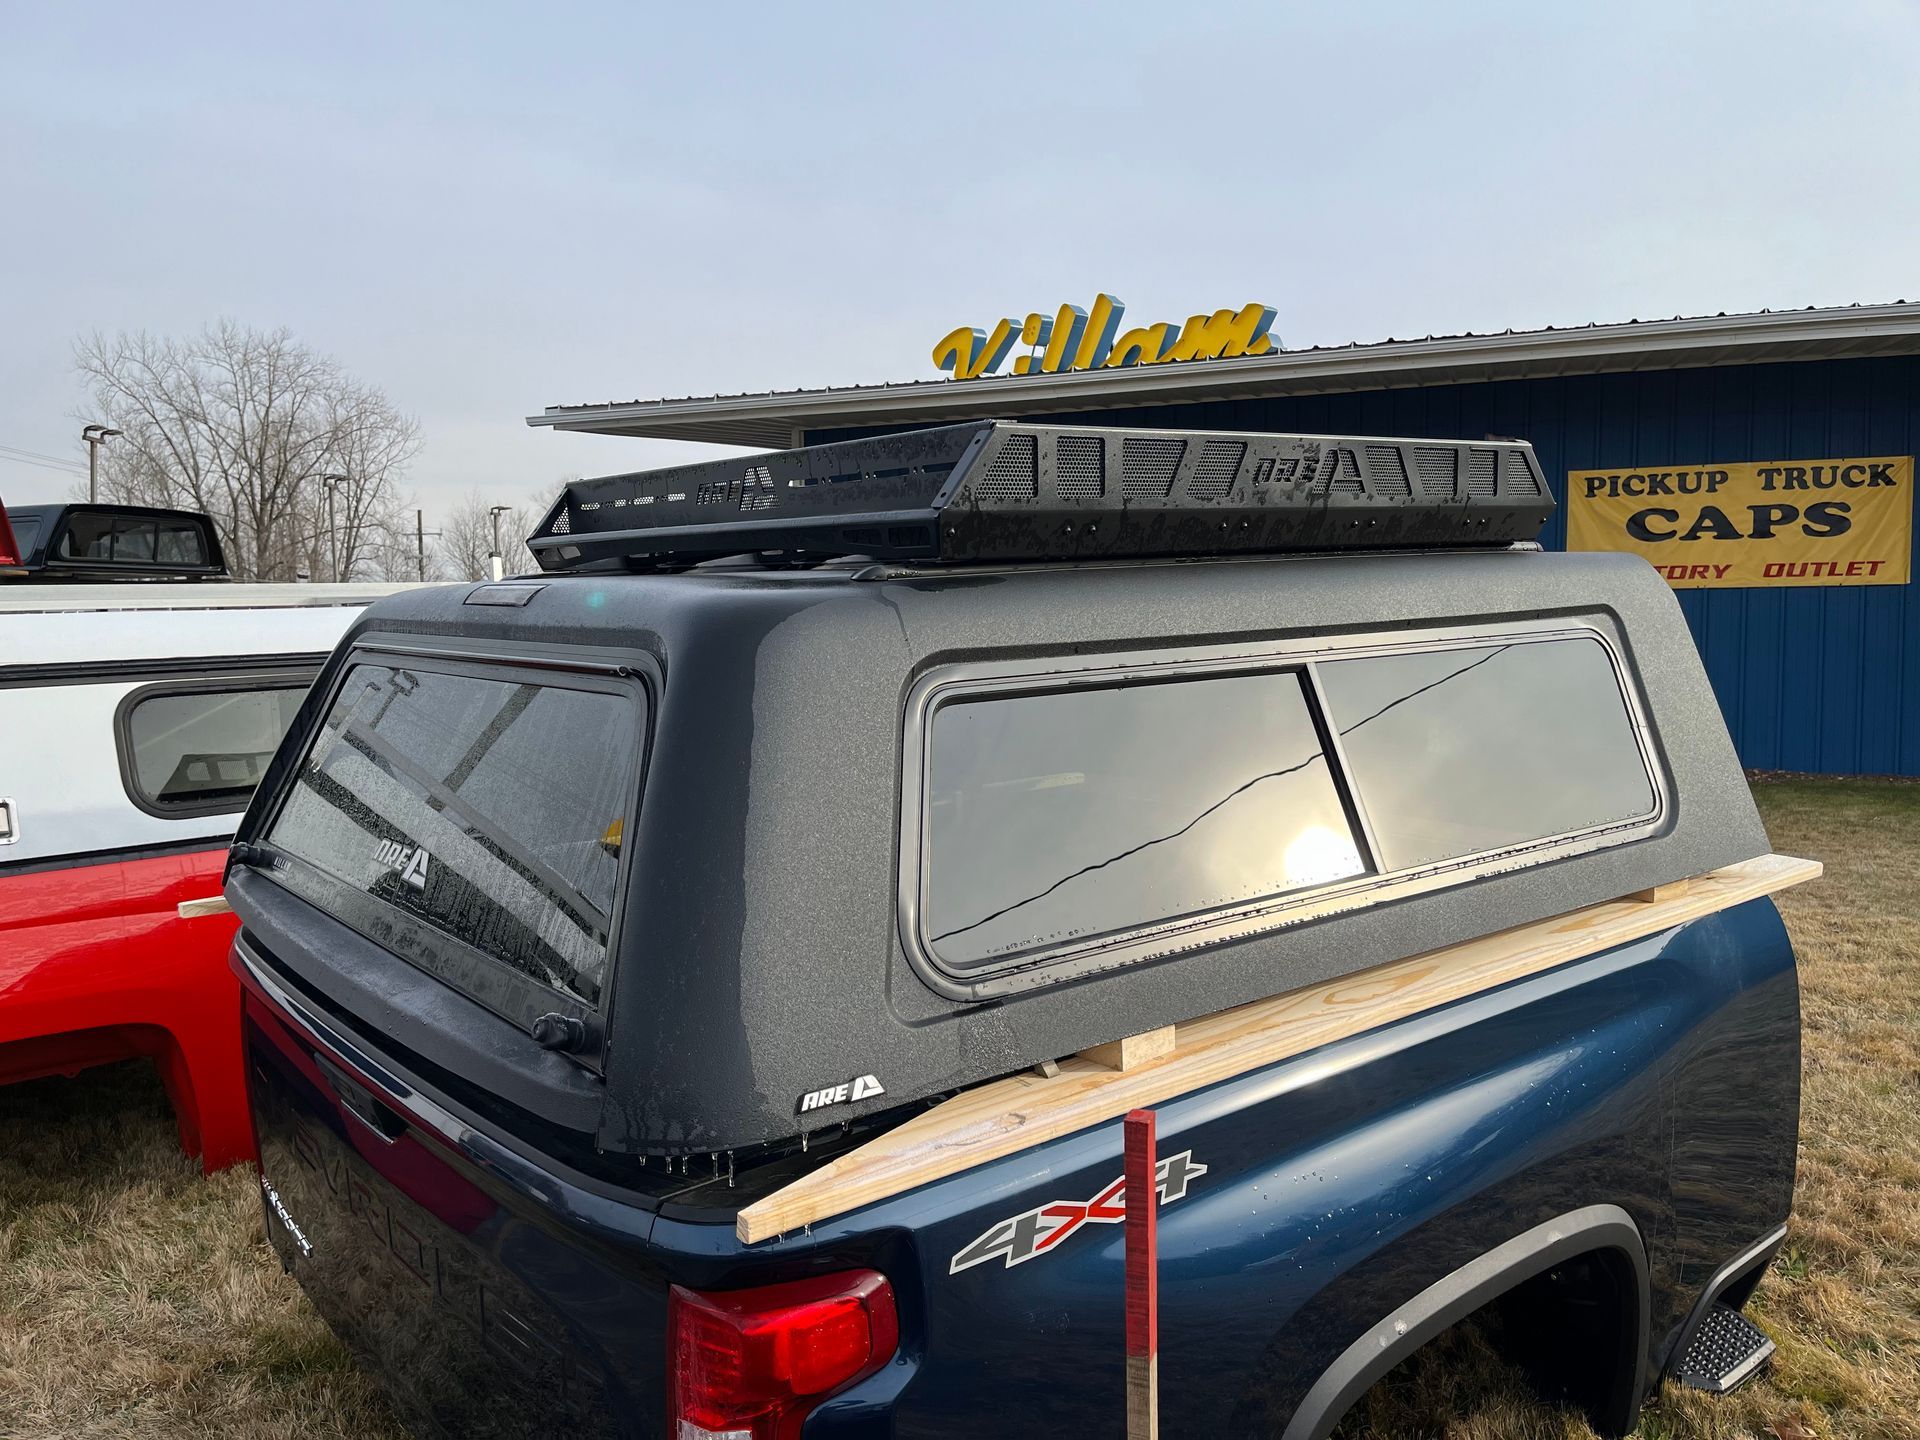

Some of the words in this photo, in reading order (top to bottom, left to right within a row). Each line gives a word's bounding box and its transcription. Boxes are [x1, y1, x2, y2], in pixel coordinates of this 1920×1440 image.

[1585, 470, 1729, 498] PICKUP
[1757, 463, 1897, 491] TRUCK
[1626, 502, 1852, 543] CAPS
[1762, 560, 1886, 578] OUTLET
